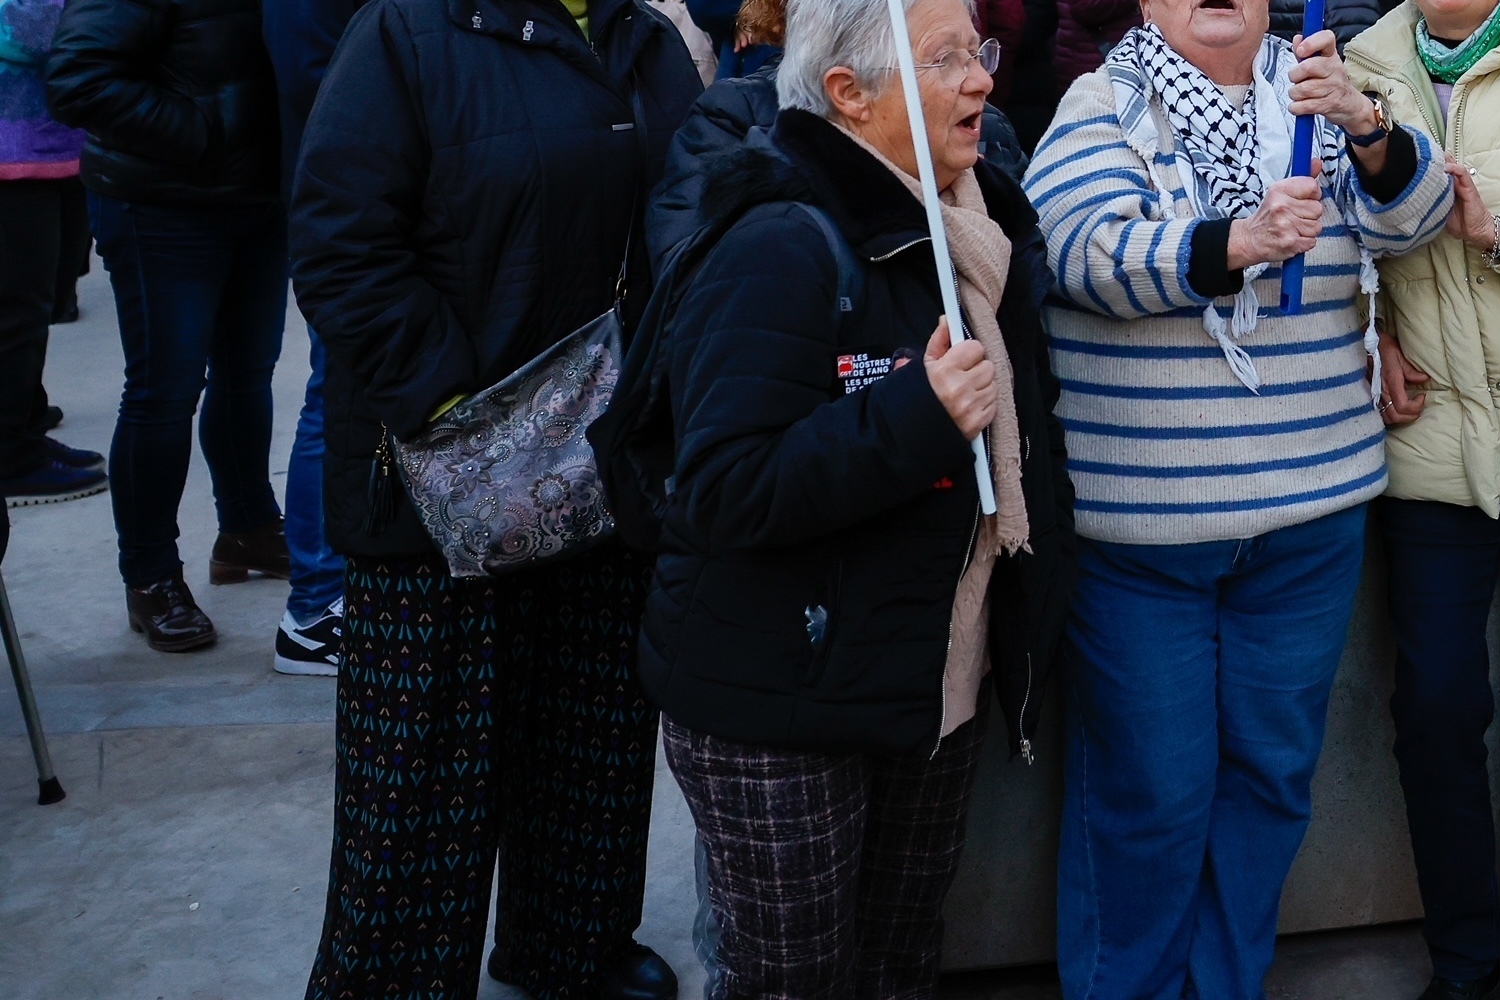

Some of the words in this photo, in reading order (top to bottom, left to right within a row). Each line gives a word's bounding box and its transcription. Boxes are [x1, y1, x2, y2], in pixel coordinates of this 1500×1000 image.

[852, 353, 868, 362] LES
[852, 357, 891, 370] NOSTRES
[853, 369, 865, 377] DE
[866, 365, 889, 376] FANG
[845, 378, 861, 387] LES
